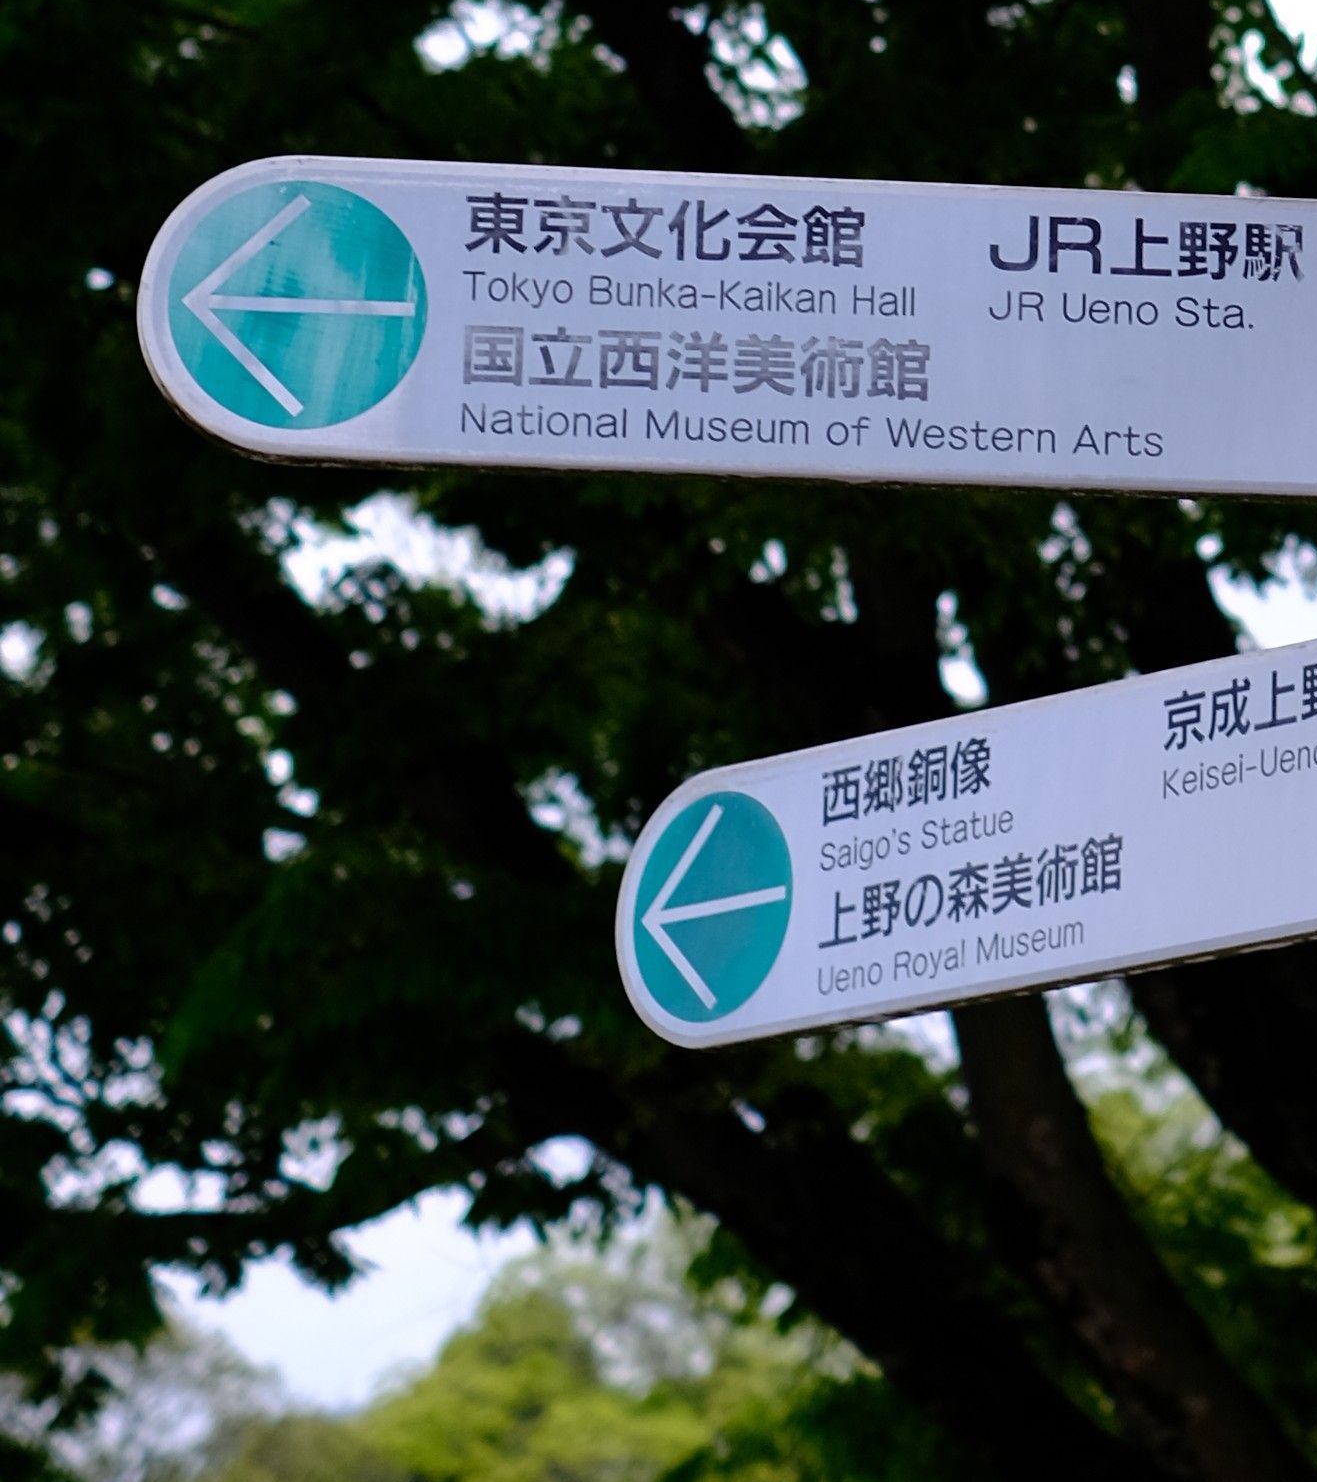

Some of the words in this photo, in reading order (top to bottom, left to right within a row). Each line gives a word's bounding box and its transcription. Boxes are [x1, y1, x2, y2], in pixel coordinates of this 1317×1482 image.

[465, 192, 864, 267] 東京文化会館
[990, 216, 1302, 281] JR上野駅
[463, 271, 573, 308] Tokyo
[590, 276, 835, 314] Bunka-Kaikan
[853, 285, 914, 316] Hall
[989, 291, 1043, 321] JR
[1063, 293, 1158, 325] Ueno
[1176, 297, 1253, 329] Sta.
[464, 326, 930, 401] 国立西洋美術館
[462, 403, 627, 438] National
[647, 409, 809, 444] Museum
[827, 417, 870, 446] of
[886, 418, 1055, 453] Western
[1073, 425, 1162, 456] Arts
[823, 738, 990, 826] 西郷銅像
[820, 829, 910, 871] Saigo's
[922, 811, 1013, 849] Statue
[819, 834, 1122, 948] 上野の森美術館
[818, 962, 882, 995] Ueno
[894, 940, 965, 980] Royal
[977, 922, 1083, 964] Museum
